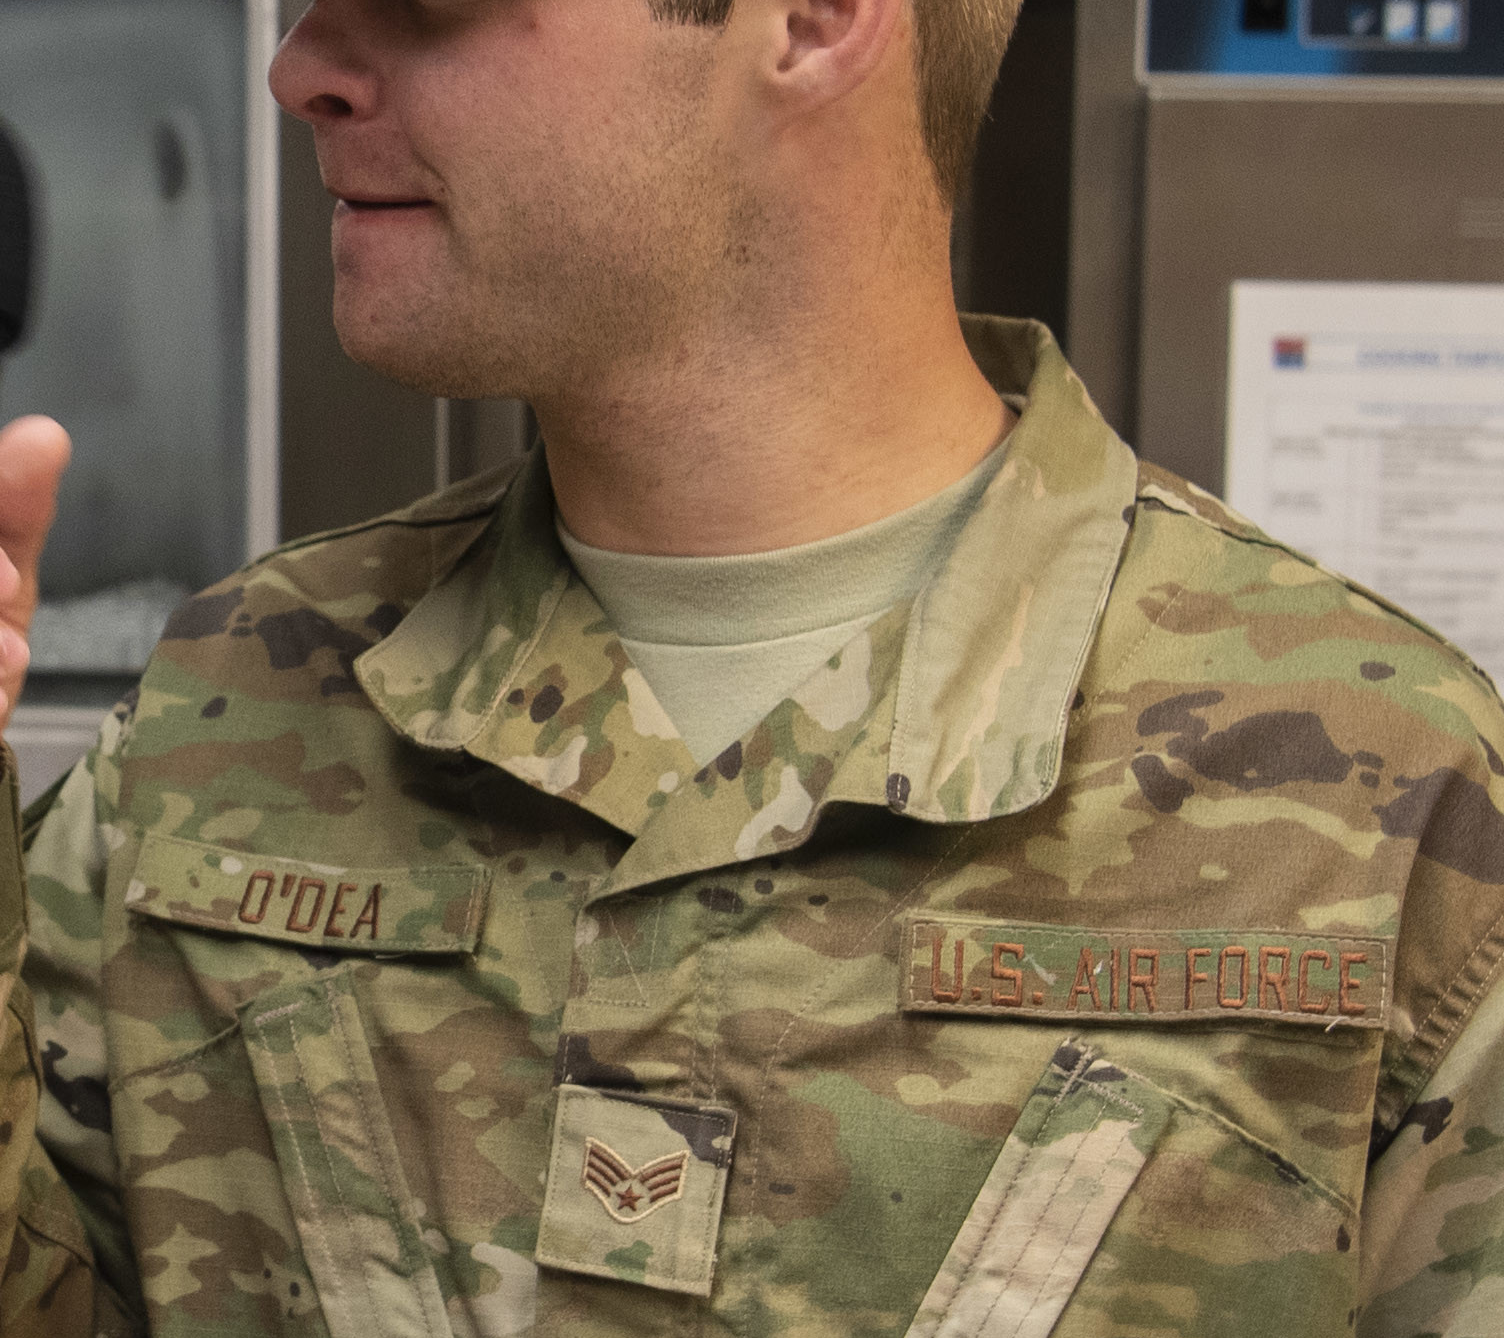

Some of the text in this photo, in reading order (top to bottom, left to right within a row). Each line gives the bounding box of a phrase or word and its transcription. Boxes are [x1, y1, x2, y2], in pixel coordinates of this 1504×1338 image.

[238, 869, 383, 939] O'DEA
[930, 936, 1368, 1015] U.S. AIR FORCE
